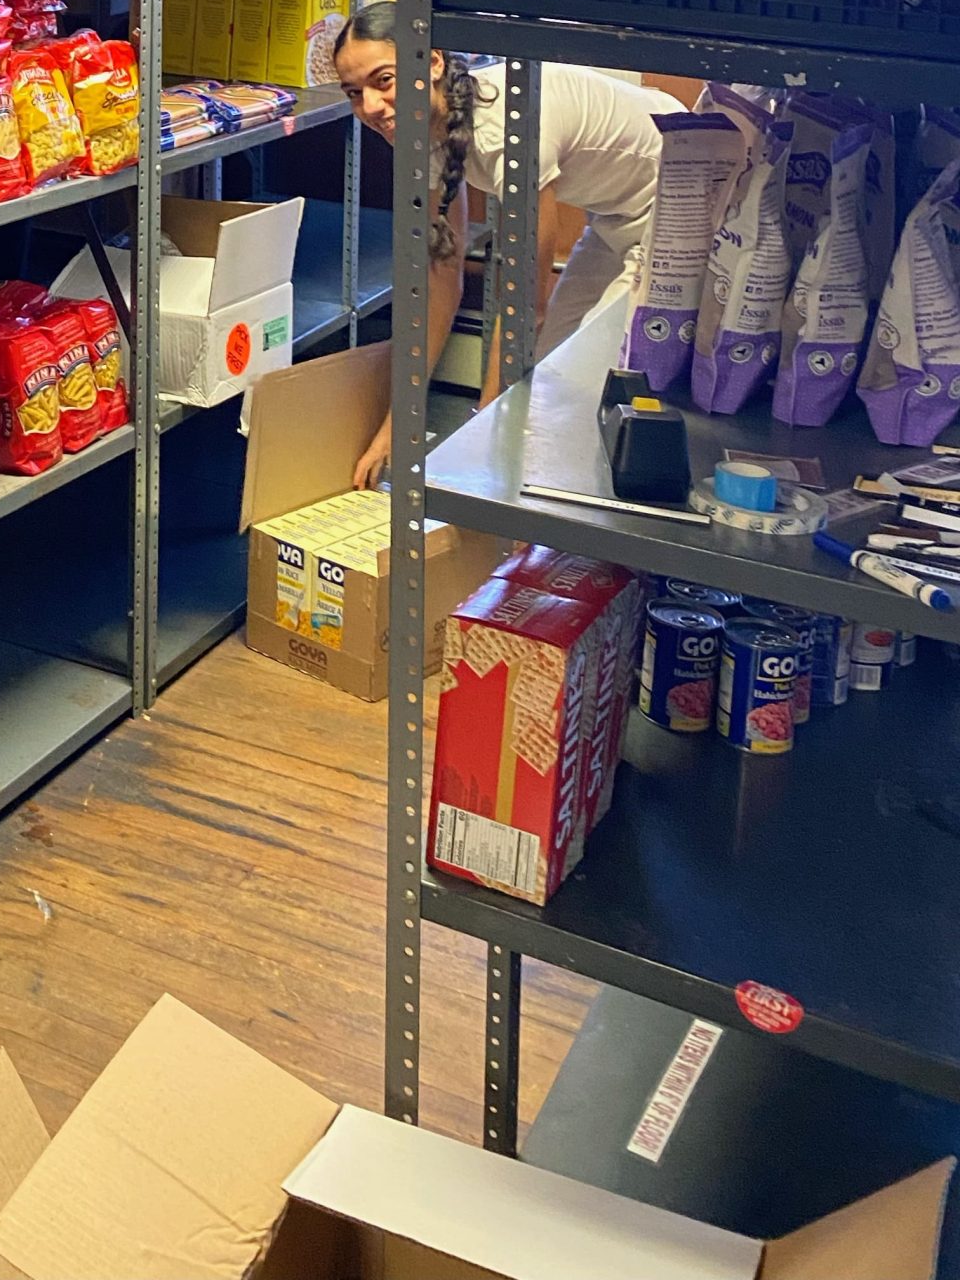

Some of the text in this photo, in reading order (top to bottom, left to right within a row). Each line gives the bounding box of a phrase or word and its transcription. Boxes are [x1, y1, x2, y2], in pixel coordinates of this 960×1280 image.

[288, 638, 328, 665] GOYA
[681, 637, 715, 657] GO
[556, 651, 586, 850] SALTINES
